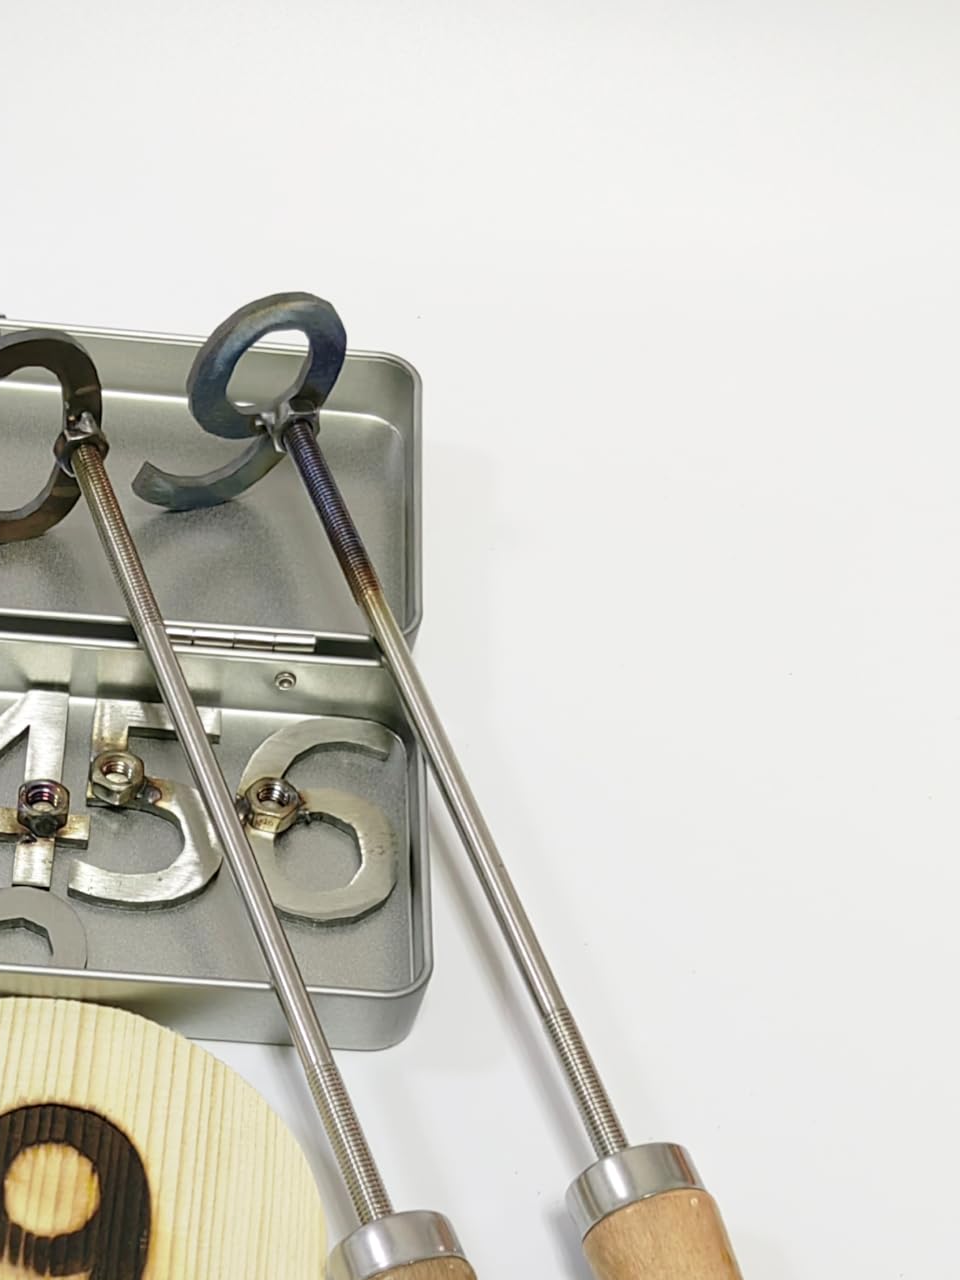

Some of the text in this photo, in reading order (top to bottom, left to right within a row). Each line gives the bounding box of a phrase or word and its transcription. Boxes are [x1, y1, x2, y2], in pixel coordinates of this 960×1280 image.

[132, 291, 347, 512] 9
[67, 700, 223, 911] 5
[236, 717, 397, 928] 6
